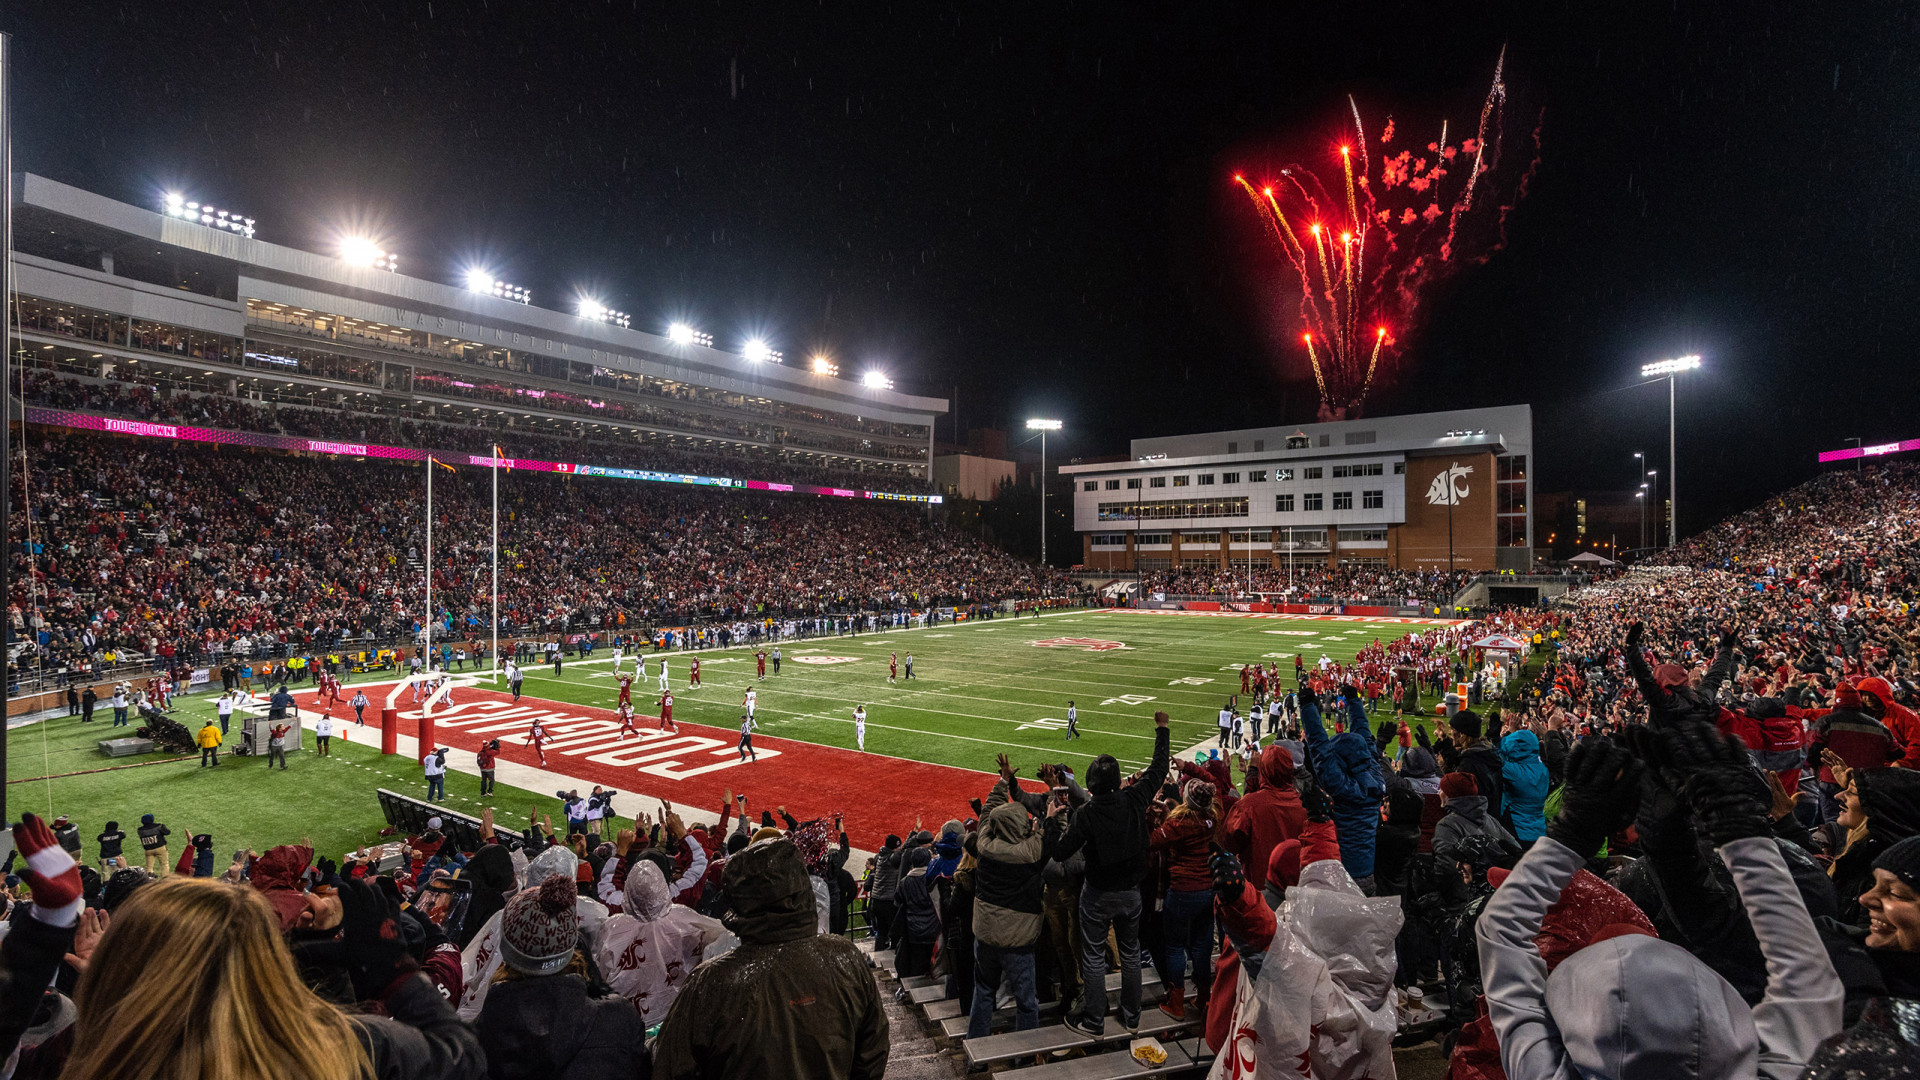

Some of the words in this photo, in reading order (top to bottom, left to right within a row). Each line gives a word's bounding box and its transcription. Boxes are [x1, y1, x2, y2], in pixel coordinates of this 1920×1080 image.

[396, 308, 568, 354] WASHINGTON
[591, 349, 646, 371] STATE
[664, 364, 766, 394] UNIVERSITY
[103, 417, 178, 438] TOUCHDOWN!
[308, 440, 367, 455] TOUCHDOWN!
[469, 455, 514, 468] TOUCHOWN!
[556, 463, 568, 472] 13
[1099, 694, 1157, 705] 20
[1015, 718, 1078, 731] 10
[396, 699, 783, 781] COUGARS
[530, 910, 551, 927] WSU
[544, 922, 570, 937] WSU
[520, 930, 550, 946] WSU
